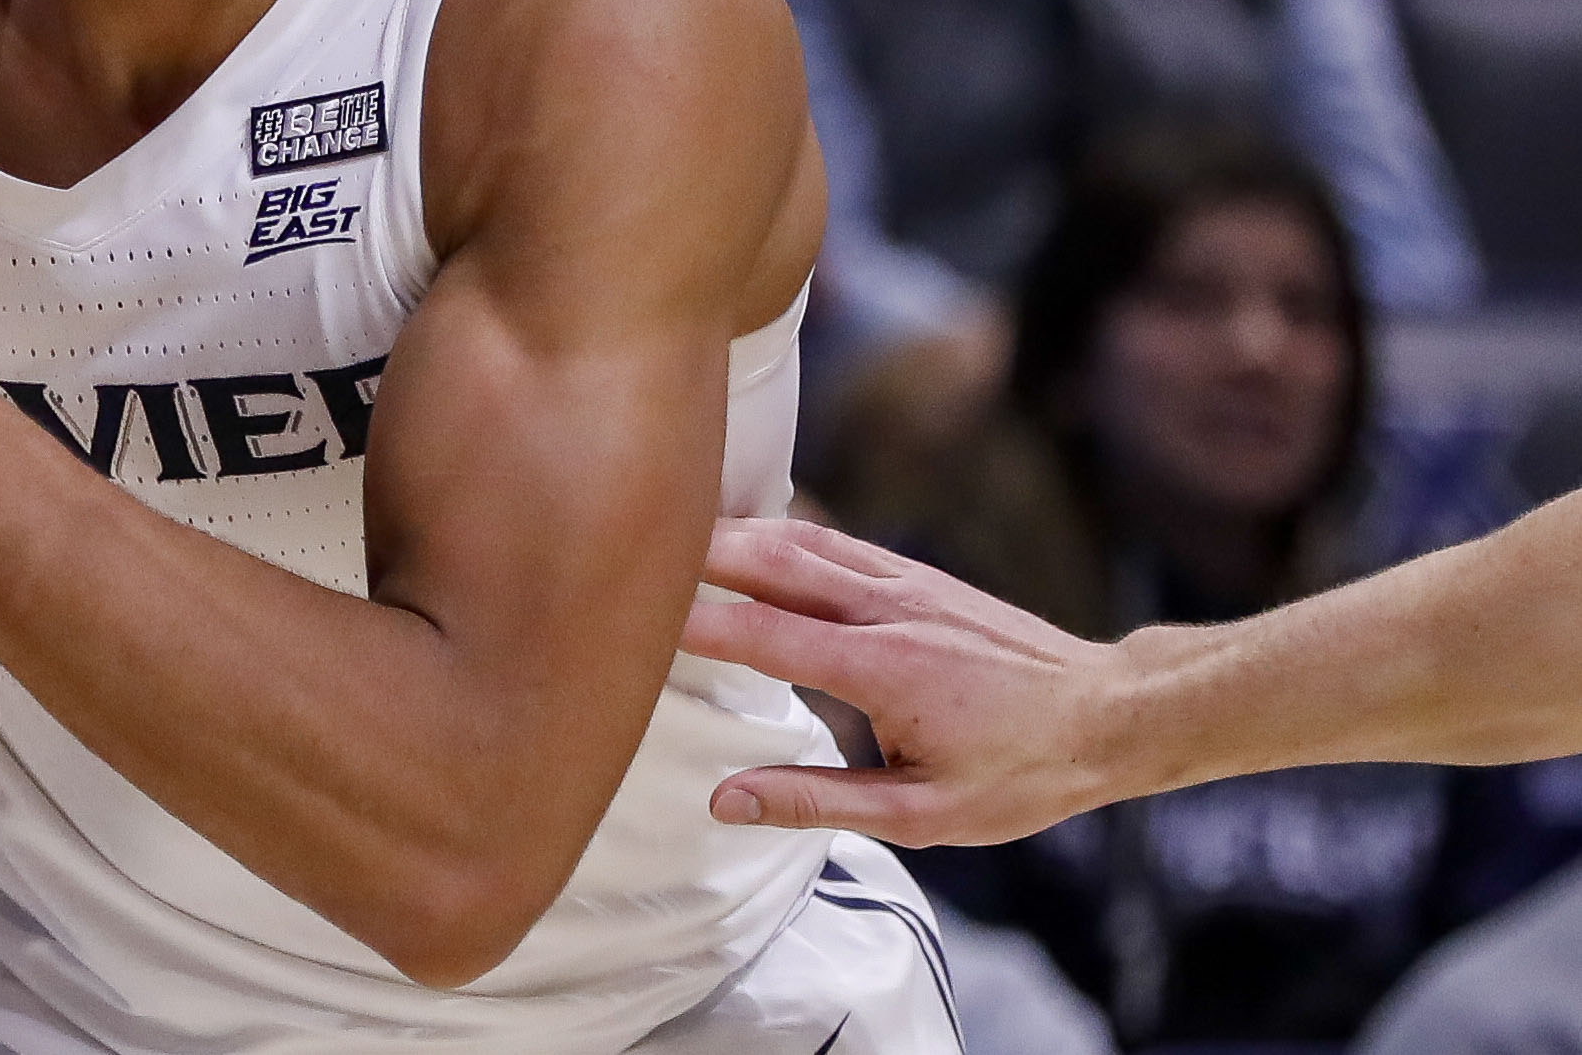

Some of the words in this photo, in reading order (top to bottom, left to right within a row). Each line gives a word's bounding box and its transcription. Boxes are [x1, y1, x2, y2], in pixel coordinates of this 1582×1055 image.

[257, 122, 380, 167] CHANGE
[256, 177, 341, 220] BIG
[249, 205, 362, 248] EAST
